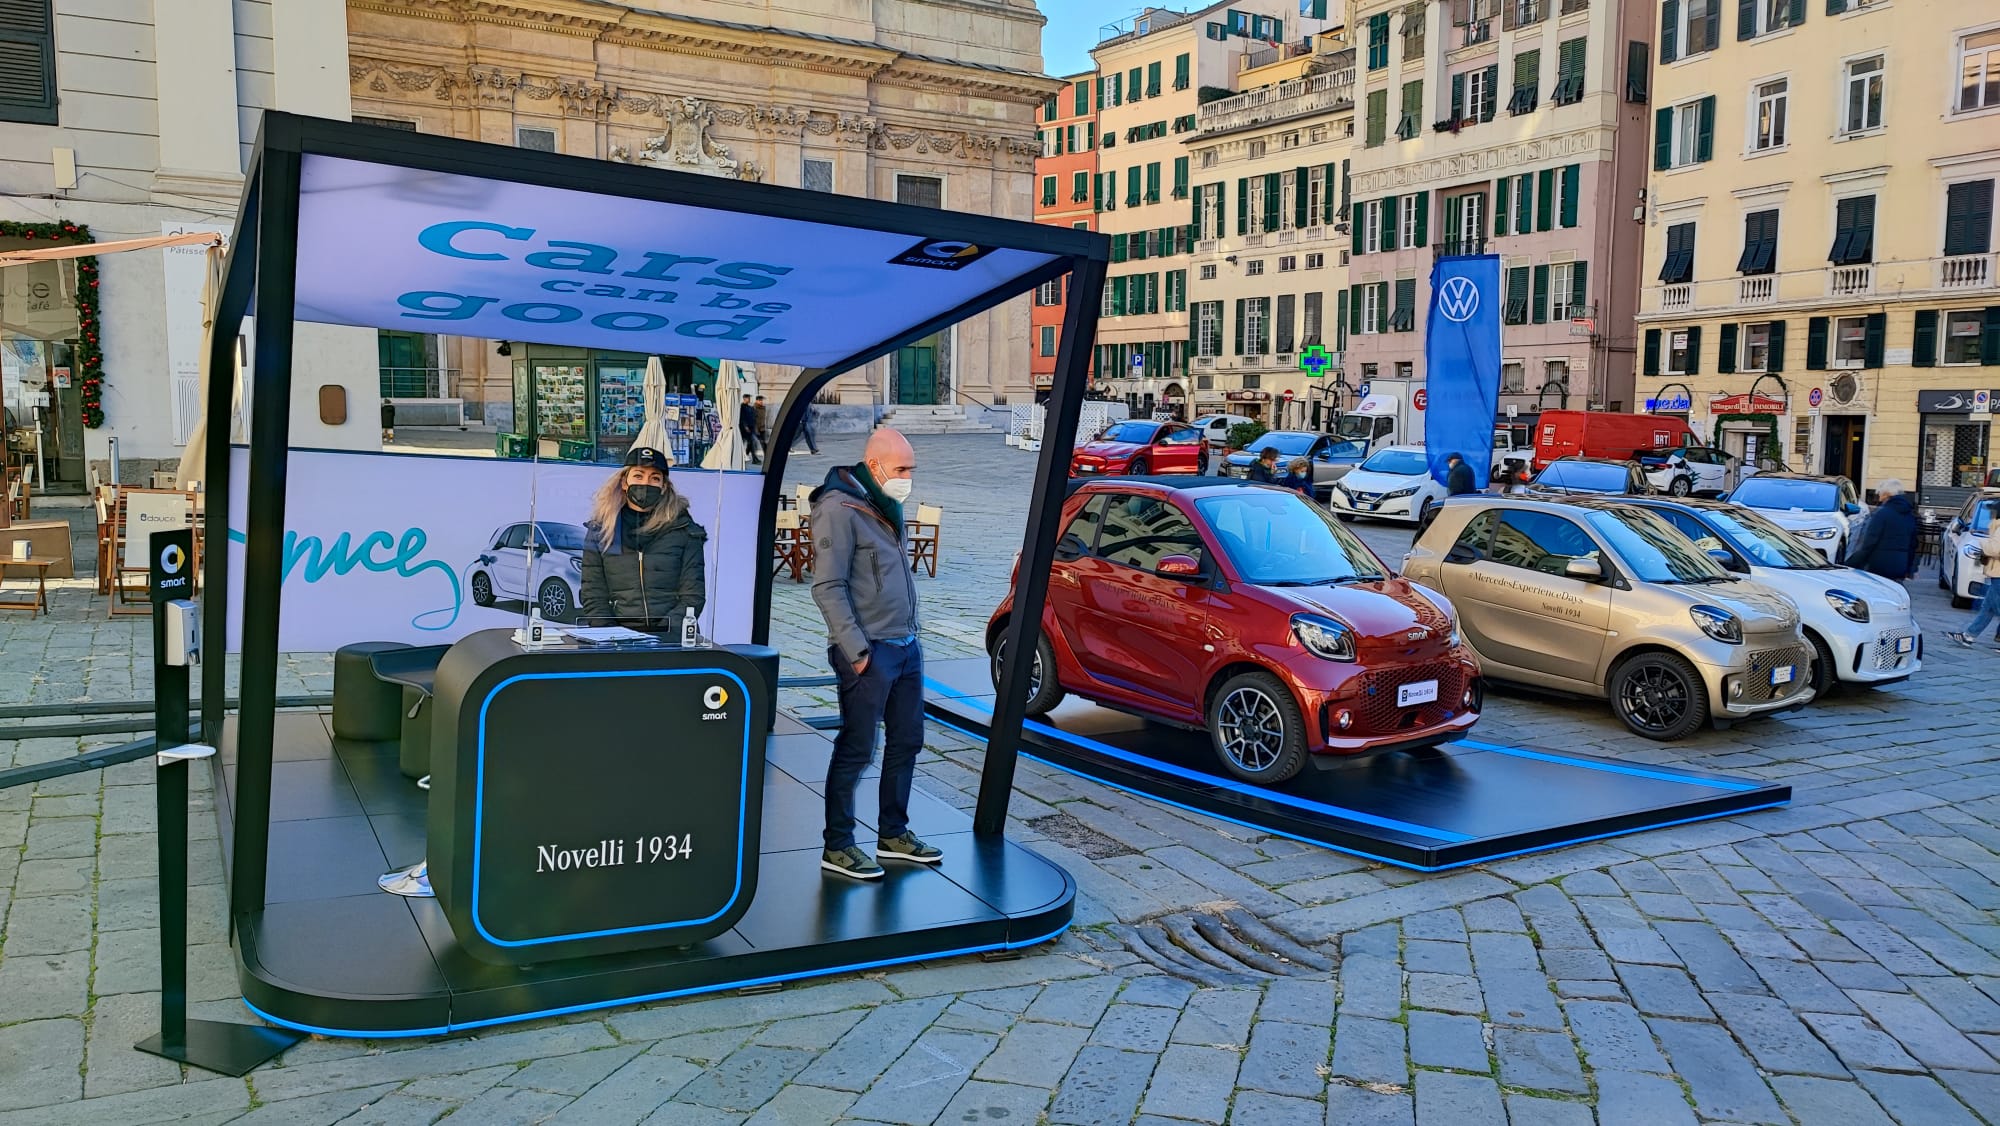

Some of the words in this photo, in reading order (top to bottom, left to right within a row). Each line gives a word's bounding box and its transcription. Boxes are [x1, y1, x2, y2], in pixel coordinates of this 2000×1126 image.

[418, 220, 793, 290] Cars
[904, 256, 959, 267] smart
[541, 280, 678, 303] can
[700, 292, 792, 313] be
[396, 290, 787, 344] good.
[1135, 355, 1142, 365] P
[1362, 386, 1368, 396] P
[281, 527, 459, 584] nice
[160, 576, 186, 588] smart
[1564, 608, 1581, 618] 1934
[702, 712, 727, 720] smart
[536, 839, 625, 873] Novelli
[635, 833, 693, 864] 1934
